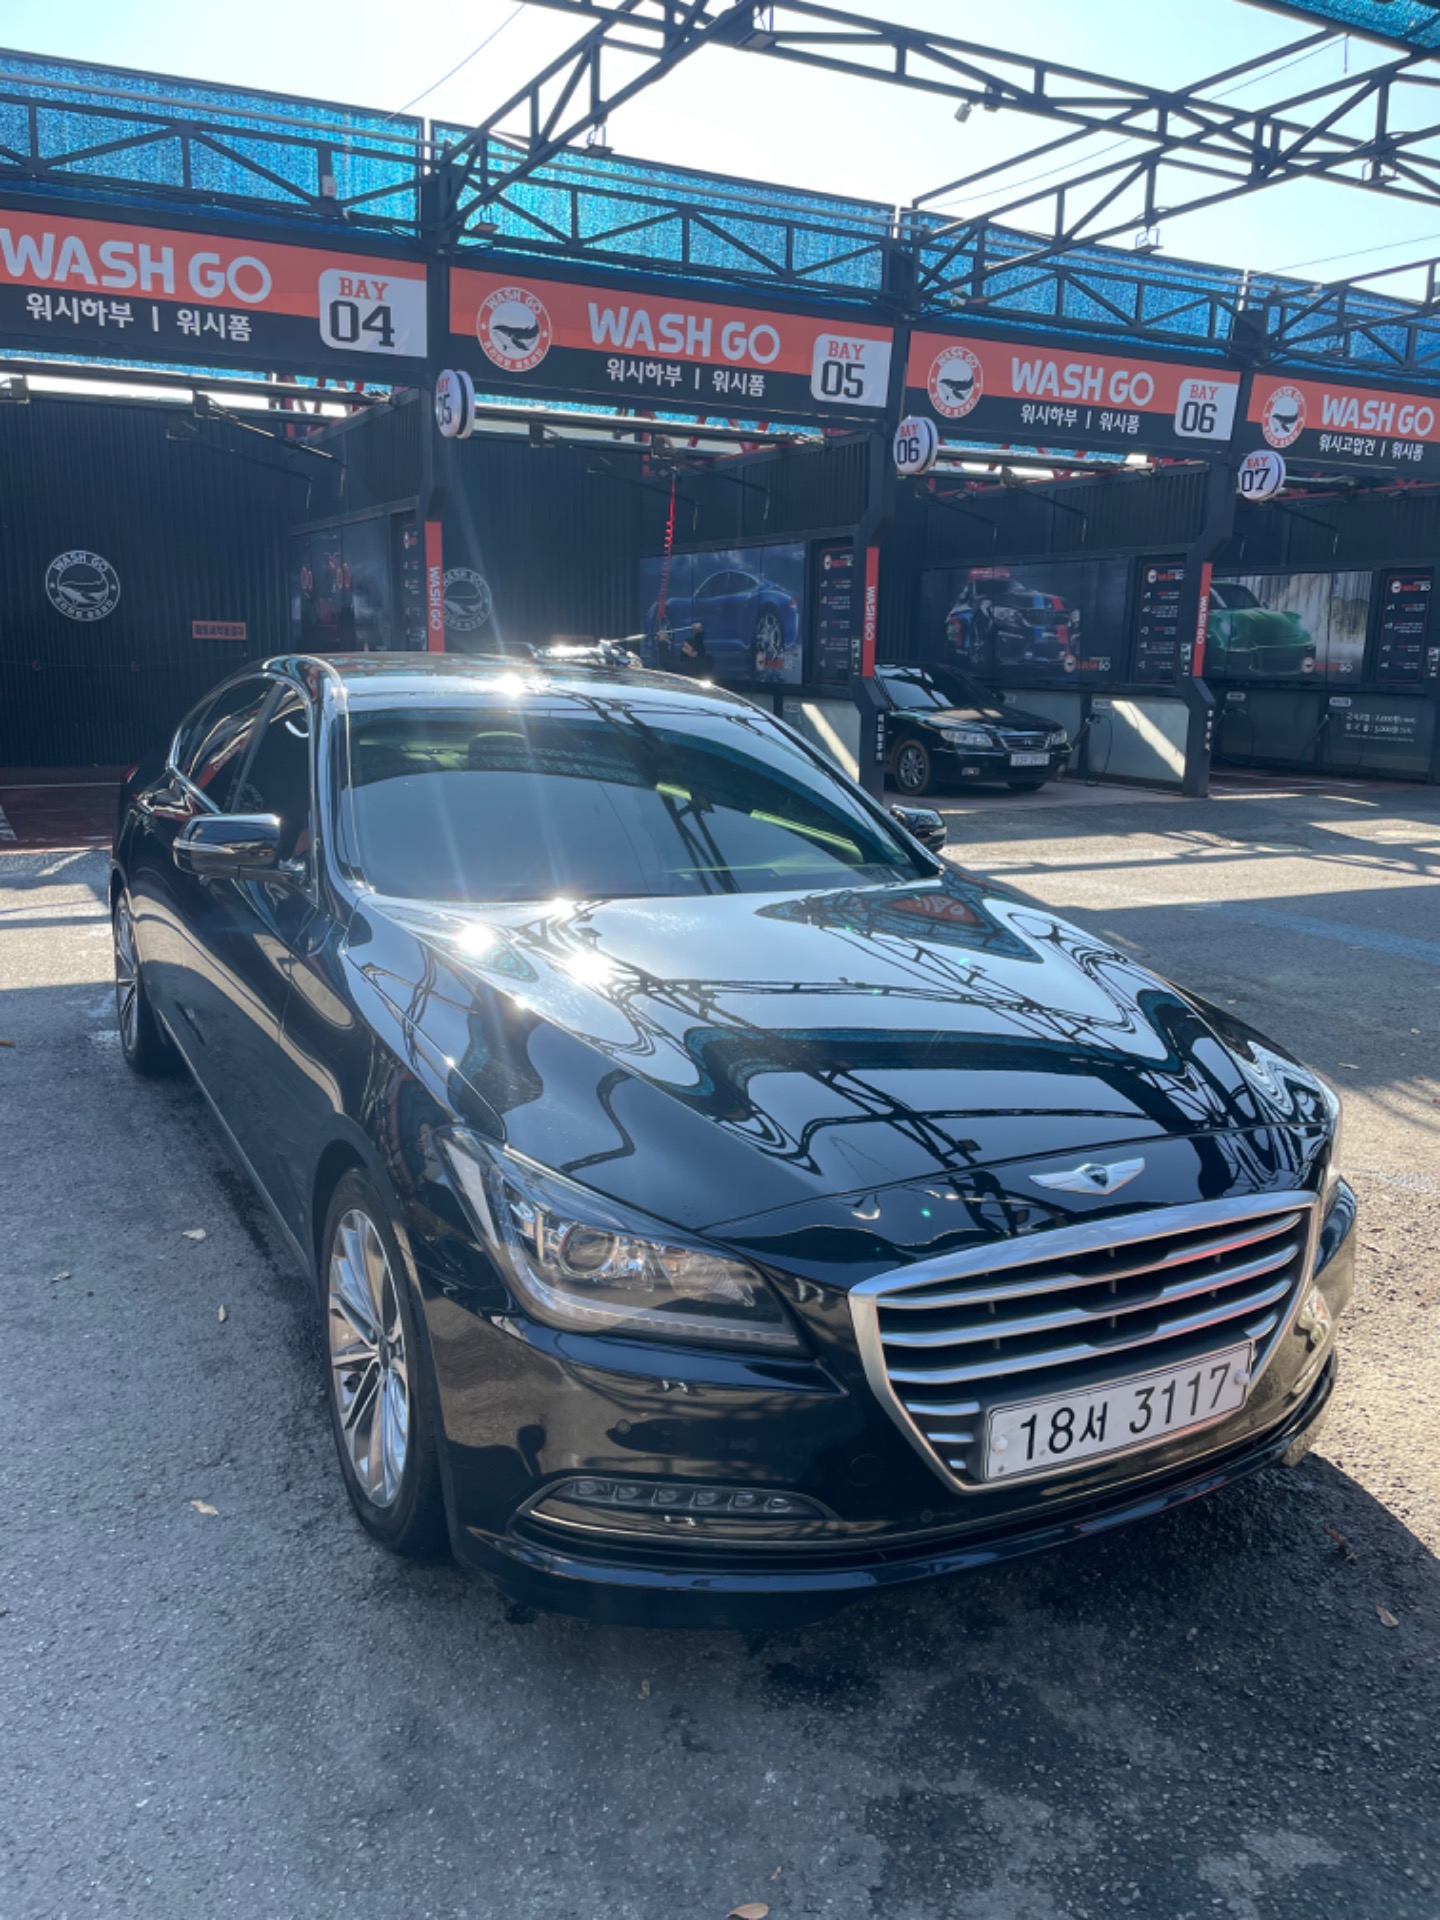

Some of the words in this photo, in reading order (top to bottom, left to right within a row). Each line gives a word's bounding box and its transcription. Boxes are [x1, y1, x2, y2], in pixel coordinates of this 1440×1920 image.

[0, 228, 175, 294] WASH
[188, 252, 272, 304] GO
[338, 276, 390, 301] BAY
[26, 293, 135, 329] 워시하부
[176, 309, 252, 342] 워시폼
[329, 299, 396, 348] 04
[588, 302, 713, 358] WASH
[721, 320, 781, 365] GO
[827, 340, 867, 363] BAY
[606, 358, 683, 389] 워시하부
[712, 369, 766, 398] 워시폼
[820, 360, 865, 399] 05
[1011, 357, 1104, 402] WASH
[1108, 370, 1155, 407] GO
[1189, 384, 1219, 401] BAY
[900, 423, 919, 438] BAY
[1020, 403, 1078, 428] 워시하부
[1099, 411, 1140, 435] 워시폼
[1181, 401, 1218, 433] 06
[1321, 394, 1396, 434] WASH
[1397, 404, 1435, 437] GO
[896, 436, 920, 466] 06
[1319, 433, 1376, 456] 워시고압건
[1247, 456, 1269, 469] BAY
[1241, 468, 1271, 492] 07
[430, 566, 441, 607] WASH
[430, 609, 442, 630] GO
[1020, 1400, 1108, 1461] 18서
[1129, 1362, 1232, 1435] 3117
